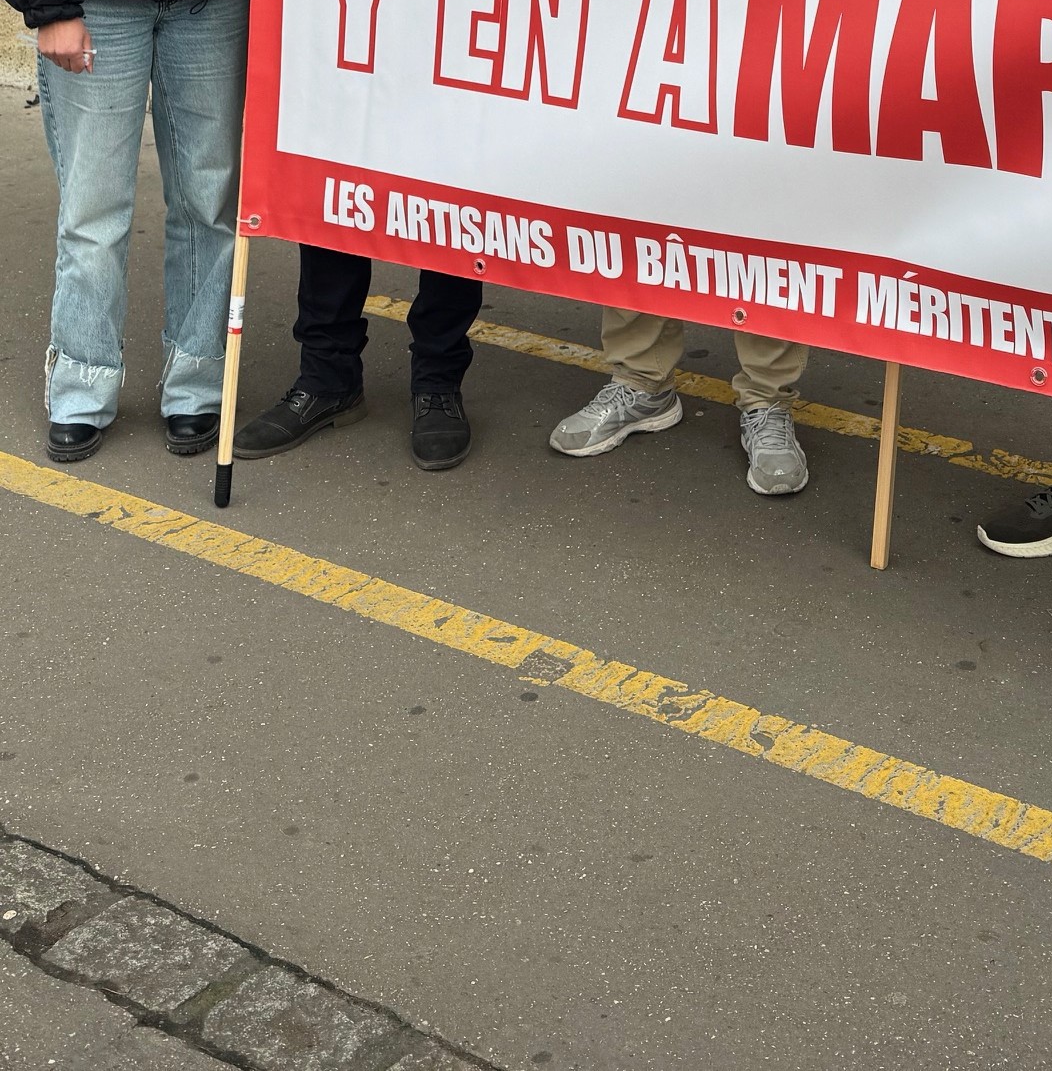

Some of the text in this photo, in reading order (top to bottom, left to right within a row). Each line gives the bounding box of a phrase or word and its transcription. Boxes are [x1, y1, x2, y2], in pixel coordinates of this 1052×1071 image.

[323, 177, 375, 232] LES
[386, 191, 555, 268] ARTISANS
[566, 227, 623, 280] DU
[636, 233, 843, 318] BÂTIMENT
